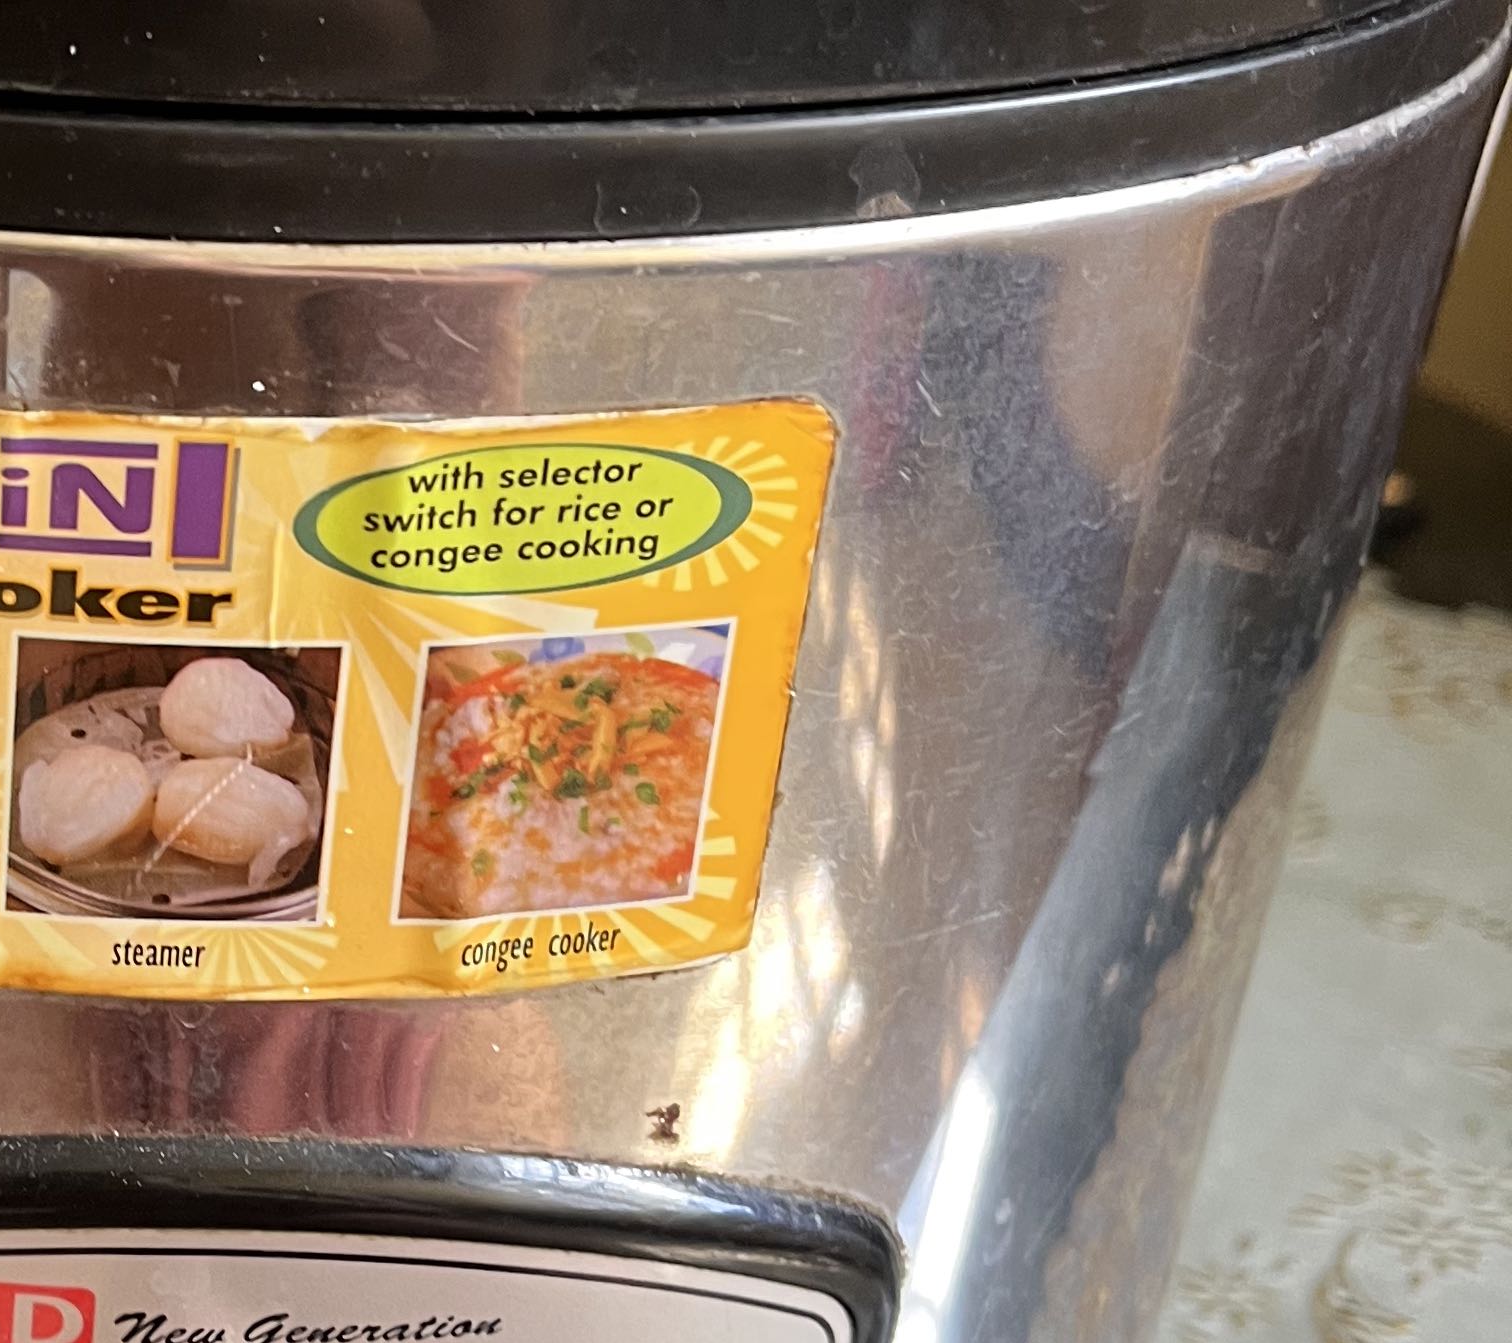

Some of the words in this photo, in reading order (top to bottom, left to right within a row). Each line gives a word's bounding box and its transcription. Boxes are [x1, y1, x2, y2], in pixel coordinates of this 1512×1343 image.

[407, 462, 483, 494] with
[497, 458, 643, 488] selector
[363, 500, 476, 532] switch
[492, 497, 544, 527] for
[556, 494, 621, 524] rice
[635, 496, 674, 518] or
[369, 543, 504, 573] congee
[518, 529, 660, 560] cooking
[111, 938, 206, 968] steamer
[461, 935, 534, 973] congee
[548, 921, 621, 957] cooker
